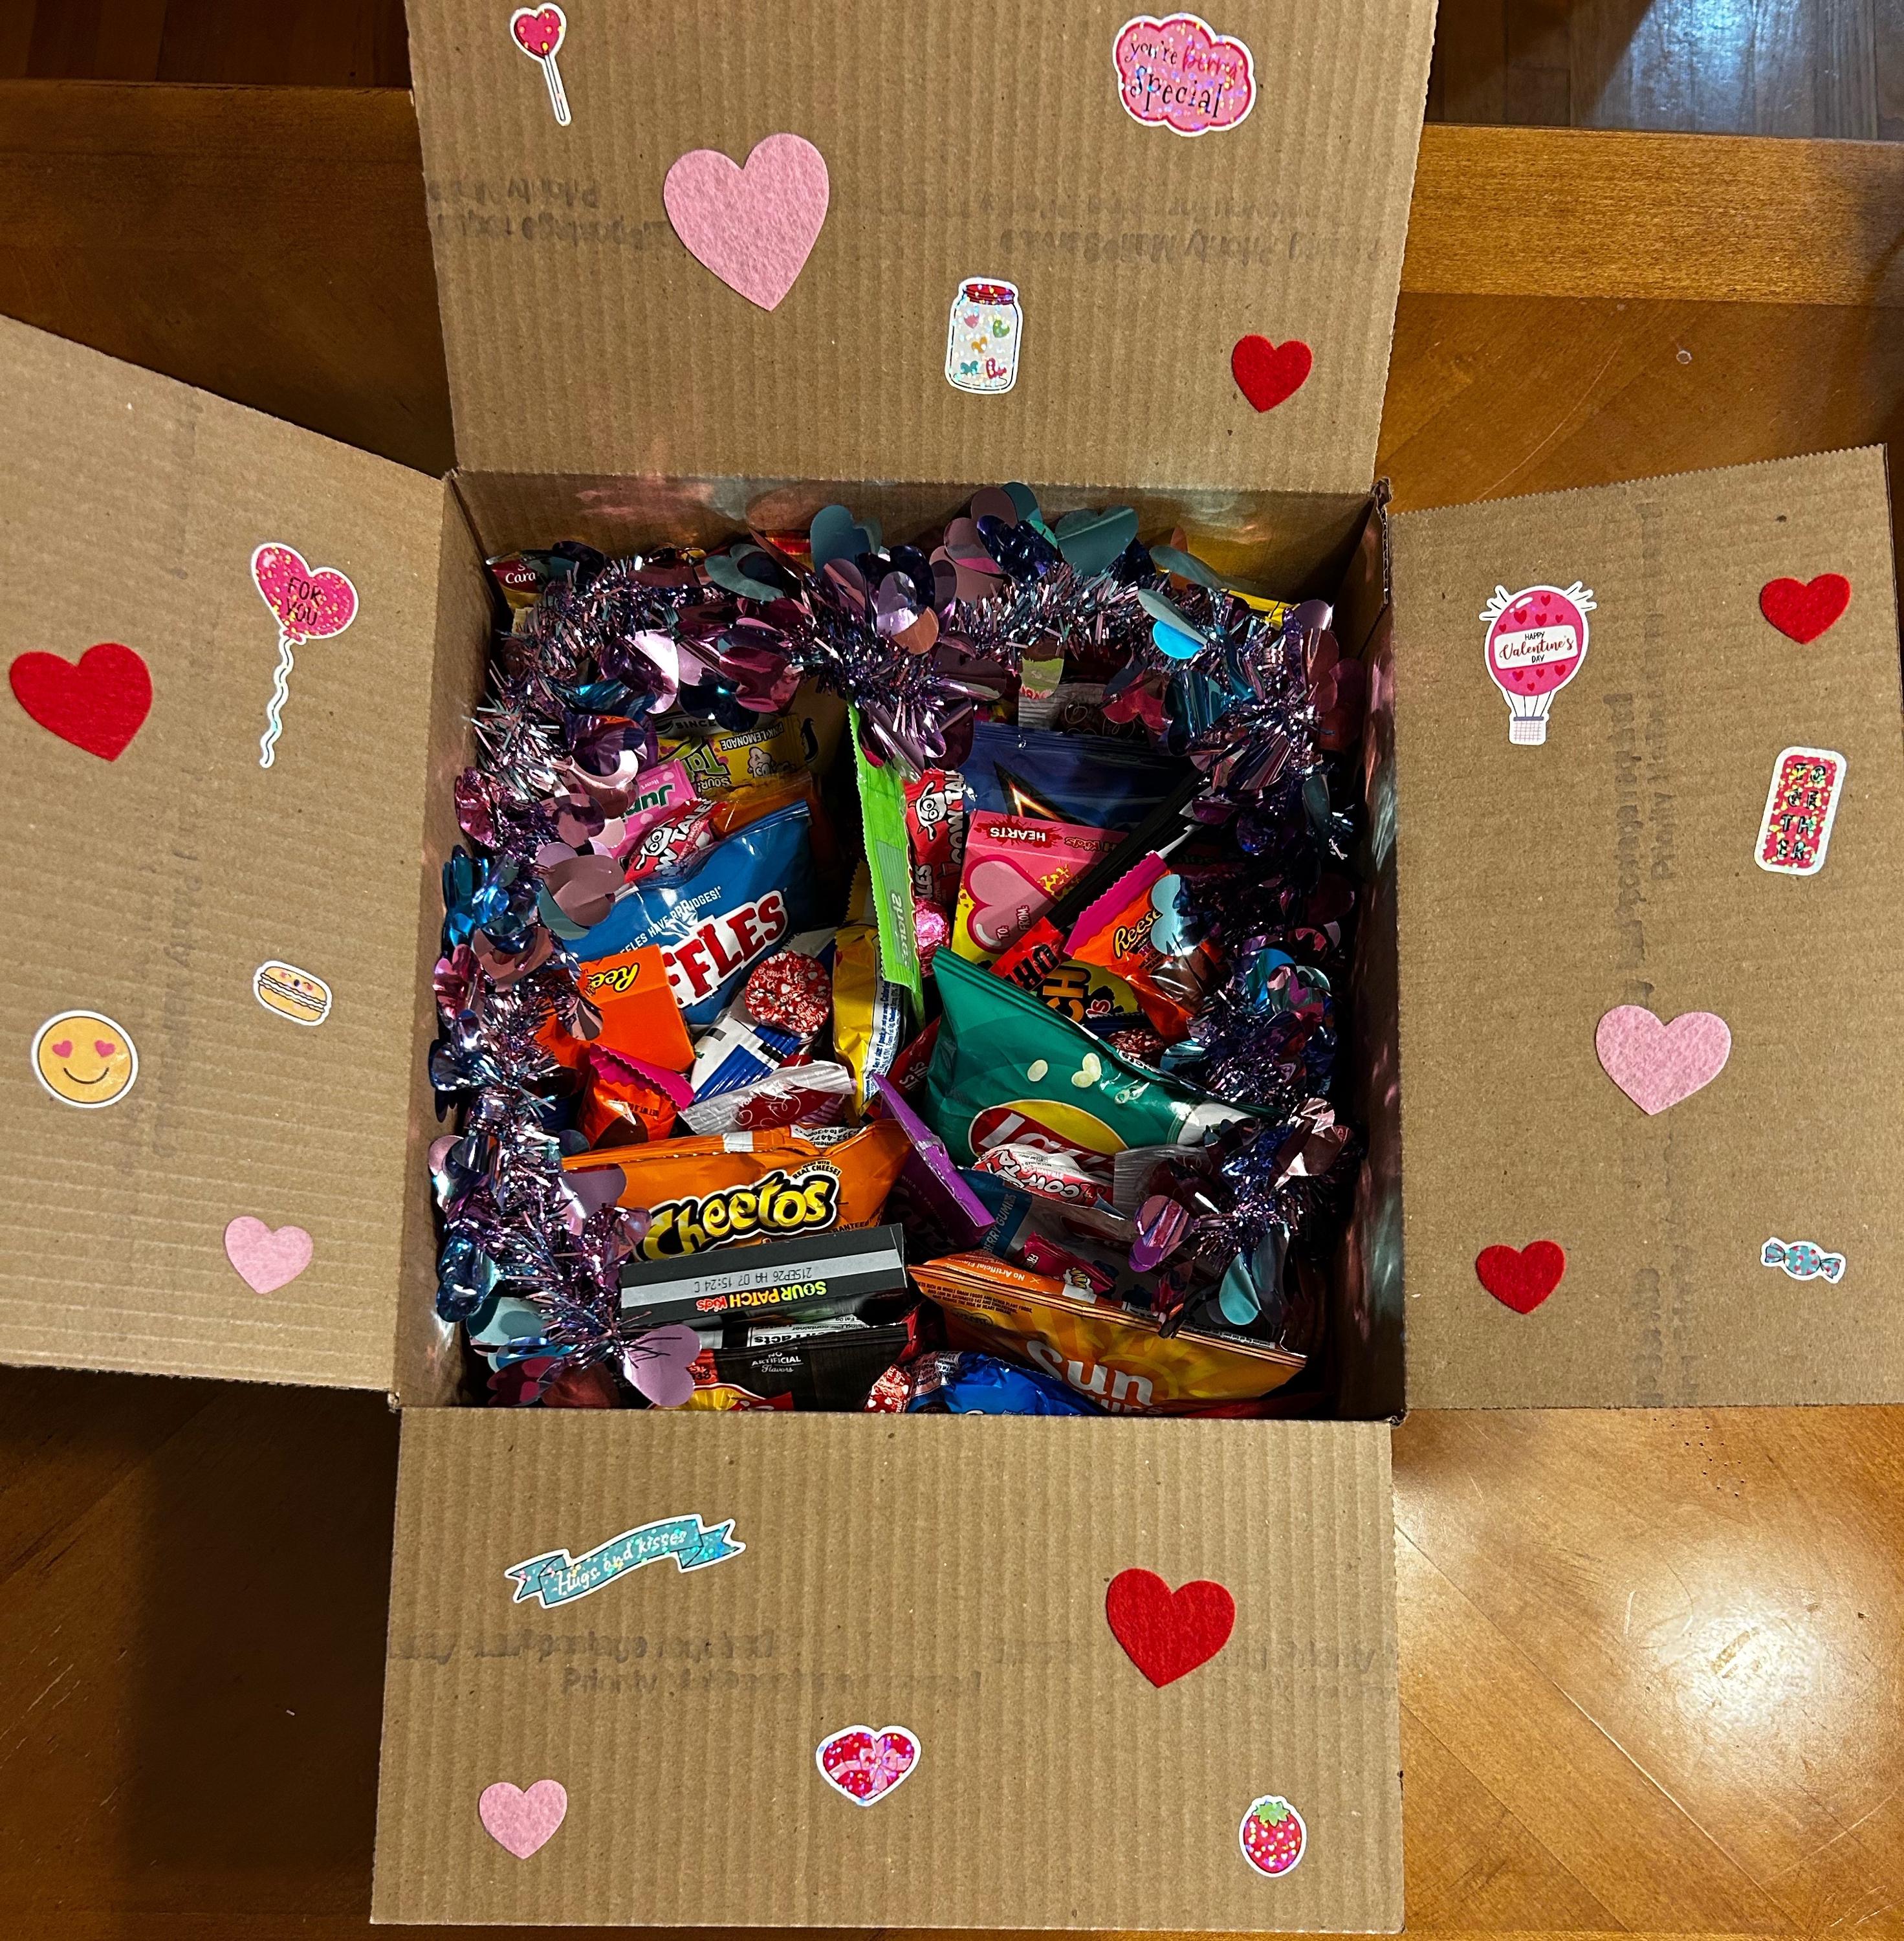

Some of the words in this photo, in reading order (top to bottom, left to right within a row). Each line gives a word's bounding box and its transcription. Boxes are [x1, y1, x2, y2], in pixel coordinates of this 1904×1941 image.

[1124, 40, 1177, 65] you're
[1183, 40, 1238, 91] berry
[1130, 65, 1223, 118] Special
[288, 576, 322, 607] FOR
[287, 597, 318, 626] YOU
[1524, 631, 1546, 641] HAPPY
[1499, 635, 1574, 660] Valentine's
[1531, 654, 1545, 663] DAY
[674, 719, 717, 729] SINCE
[721, 729, 768, 751] LEMONADE
[697, 777, 732, 793] SOUR!
[990, 827, 1046, 842] HEARTS
[647, 916, 670, 938] HAVE
[1018, 905, 1031, 931] FROM:
[997, 925, 1009, 939] TO:
[793, 1167, 811, 1180] REAL
[811, 1164, 841, 1176] CHEESE!
[1022, 1173, 1081, 1198] COW
[644, 1178, 830, 1260] Cheetos
[755, 1272, 768, 1284] HA
[773, 1267, 813, 1282] 21SEP26
[976, 1263, 1013, 1278] Artificial
[1013, 1273, 1025, 1281] No
[705, 1277, 732, 1292] 15:24
[780, 1281, 827, 1301] SOUR
[695, 1295, 728, 1313] Kids
[730, 1288, 781, 1308] PATCH
[754, 1333, 801, 1344] acts
[761, 1364, 794, 1373] Flavors
[1026, 1340, 1154, 1407] Sun
[556, 1566, 598, 1596] Hugs
[603, 1541, 634, 1572] and
[637, 1530, 688, 1558] kisses
